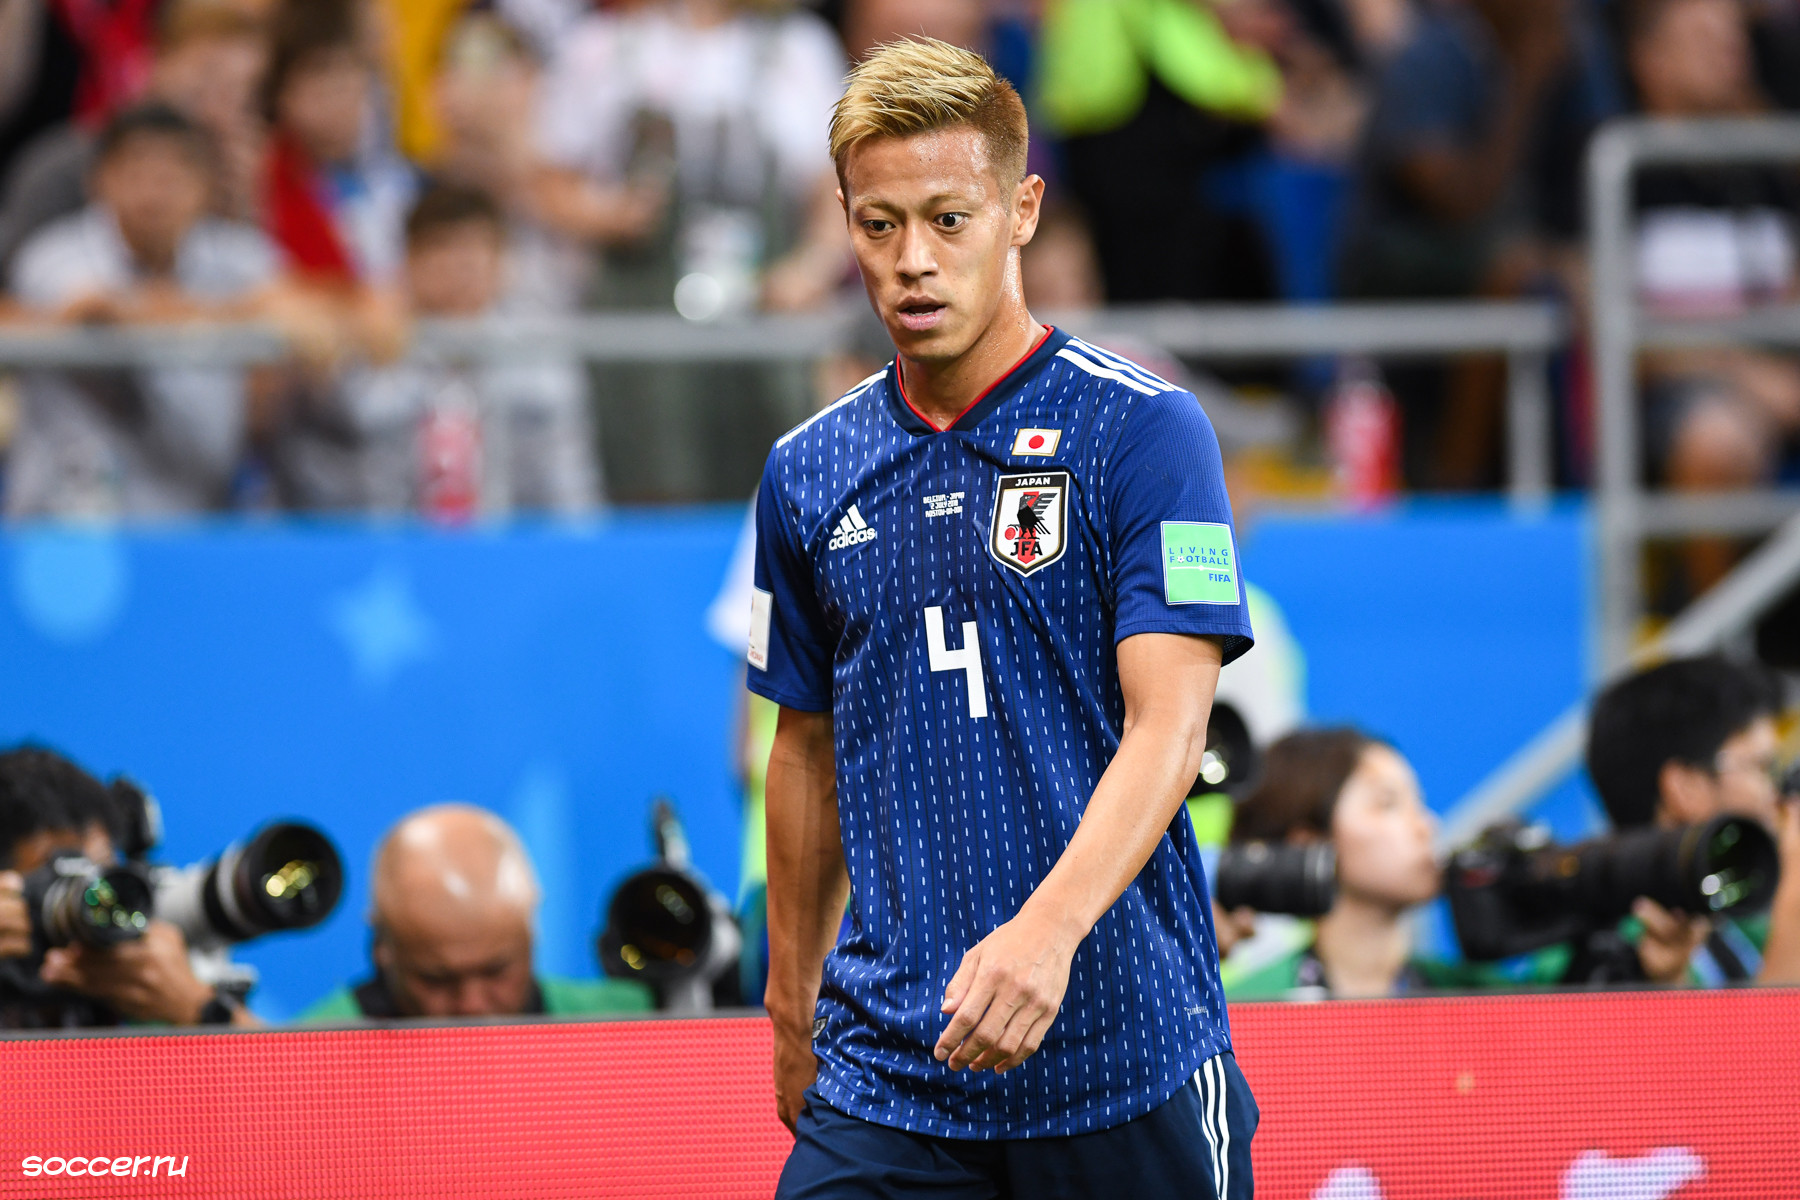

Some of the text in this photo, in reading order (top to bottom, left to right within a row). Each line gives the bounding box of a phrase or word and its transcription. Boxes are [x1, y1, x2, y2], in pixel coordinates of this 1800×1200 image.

[1015, 477, 1051, 486] JAPAN
[828, 527, 876, 551] adidas
[1010, 541, 1043, 556] JFA
[1169, 547, 1228, 556] LIVING
[1208, 573, 1231, 583] FIFA
[924, 605, 988, 718] 4
